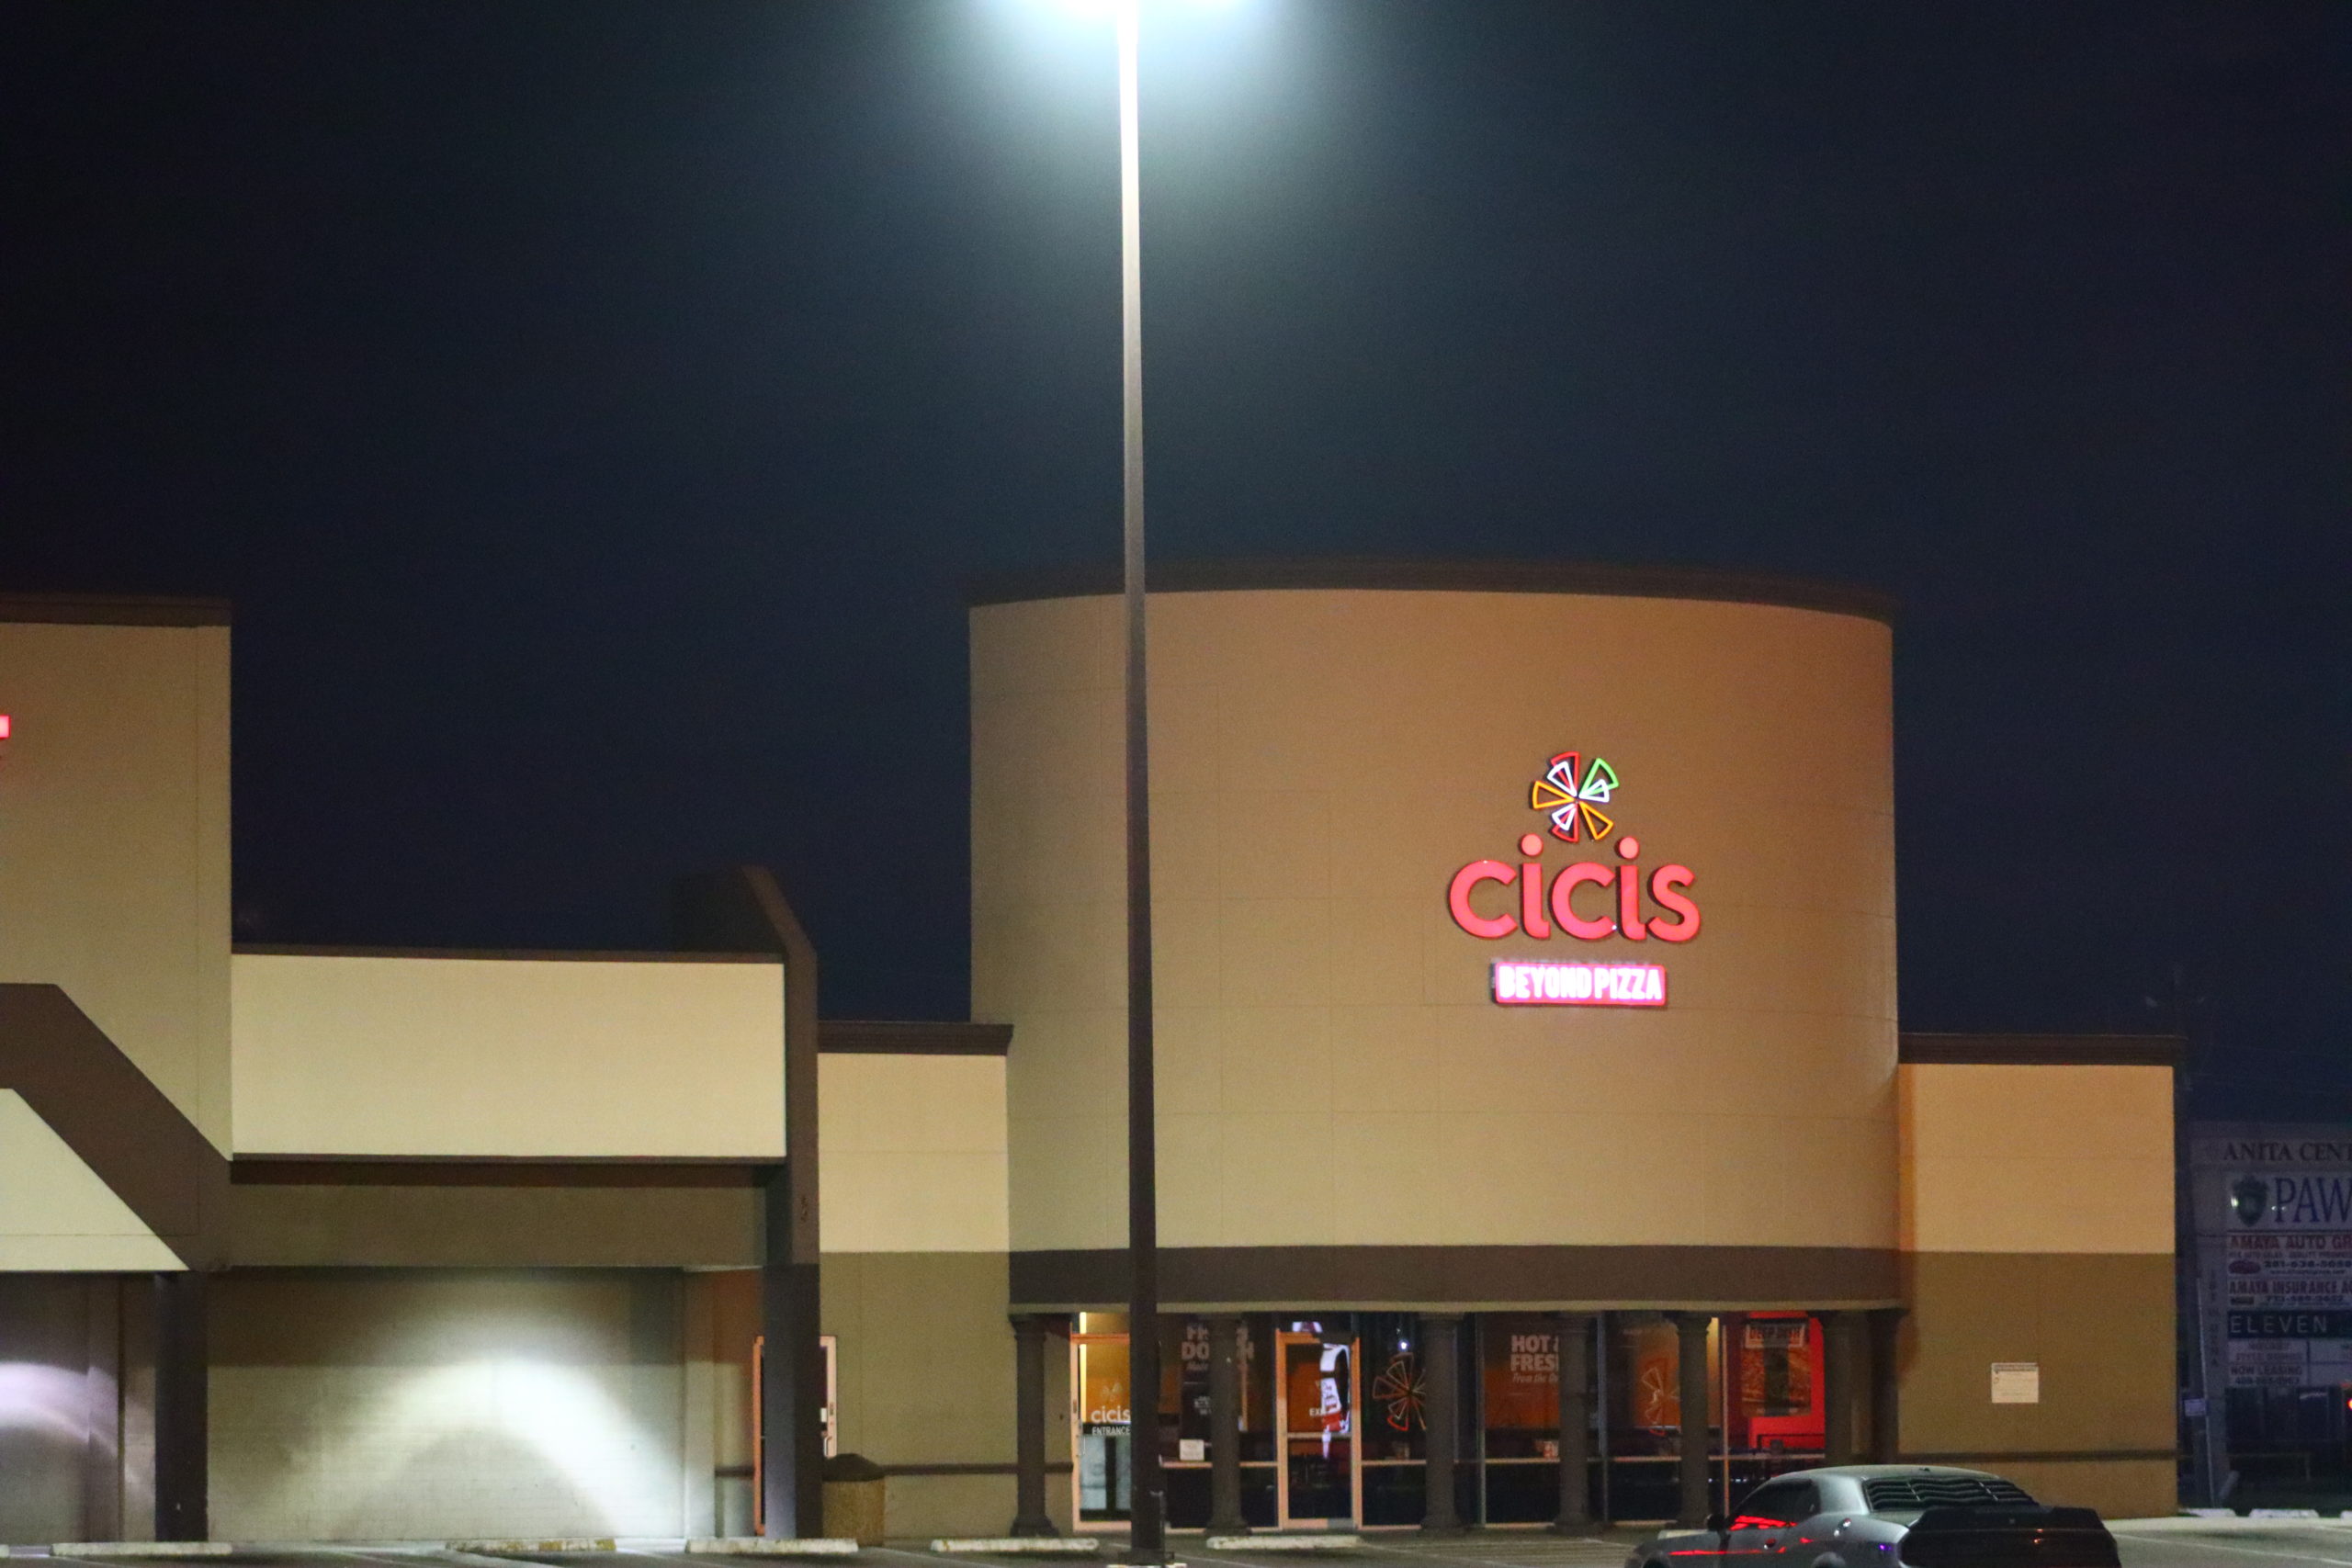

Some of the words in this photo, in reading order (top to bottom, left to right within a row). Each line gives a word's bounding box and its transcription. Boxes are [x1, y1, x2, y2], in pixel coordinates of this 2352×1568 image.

[1449, 833, 1701, 942] cicis
[1498, 965, 1592, 999] BEYOND
[1594, 967, 1662, 1000] PIZZA
[2223, 1143, 2294, 1161] ANITA
[2274, 1177, 2352, 1223] PAW
[2231, 1235, 2280, 1249] AMAYA
[2286, 1235, 2326, 1249] AUTO
[2229, 1281, 2268, 1293] AMAYA
[2273, 1281, 2337, 1293] INSURANCE
[2231, 1315, 2327, 1334] ELEVEN
[1511, 1335, 1550, 1353] HOT
[1091, 1405, 1131, 1424] cicis
[1091, 1426, 1131, 1436] ENTRANCE
